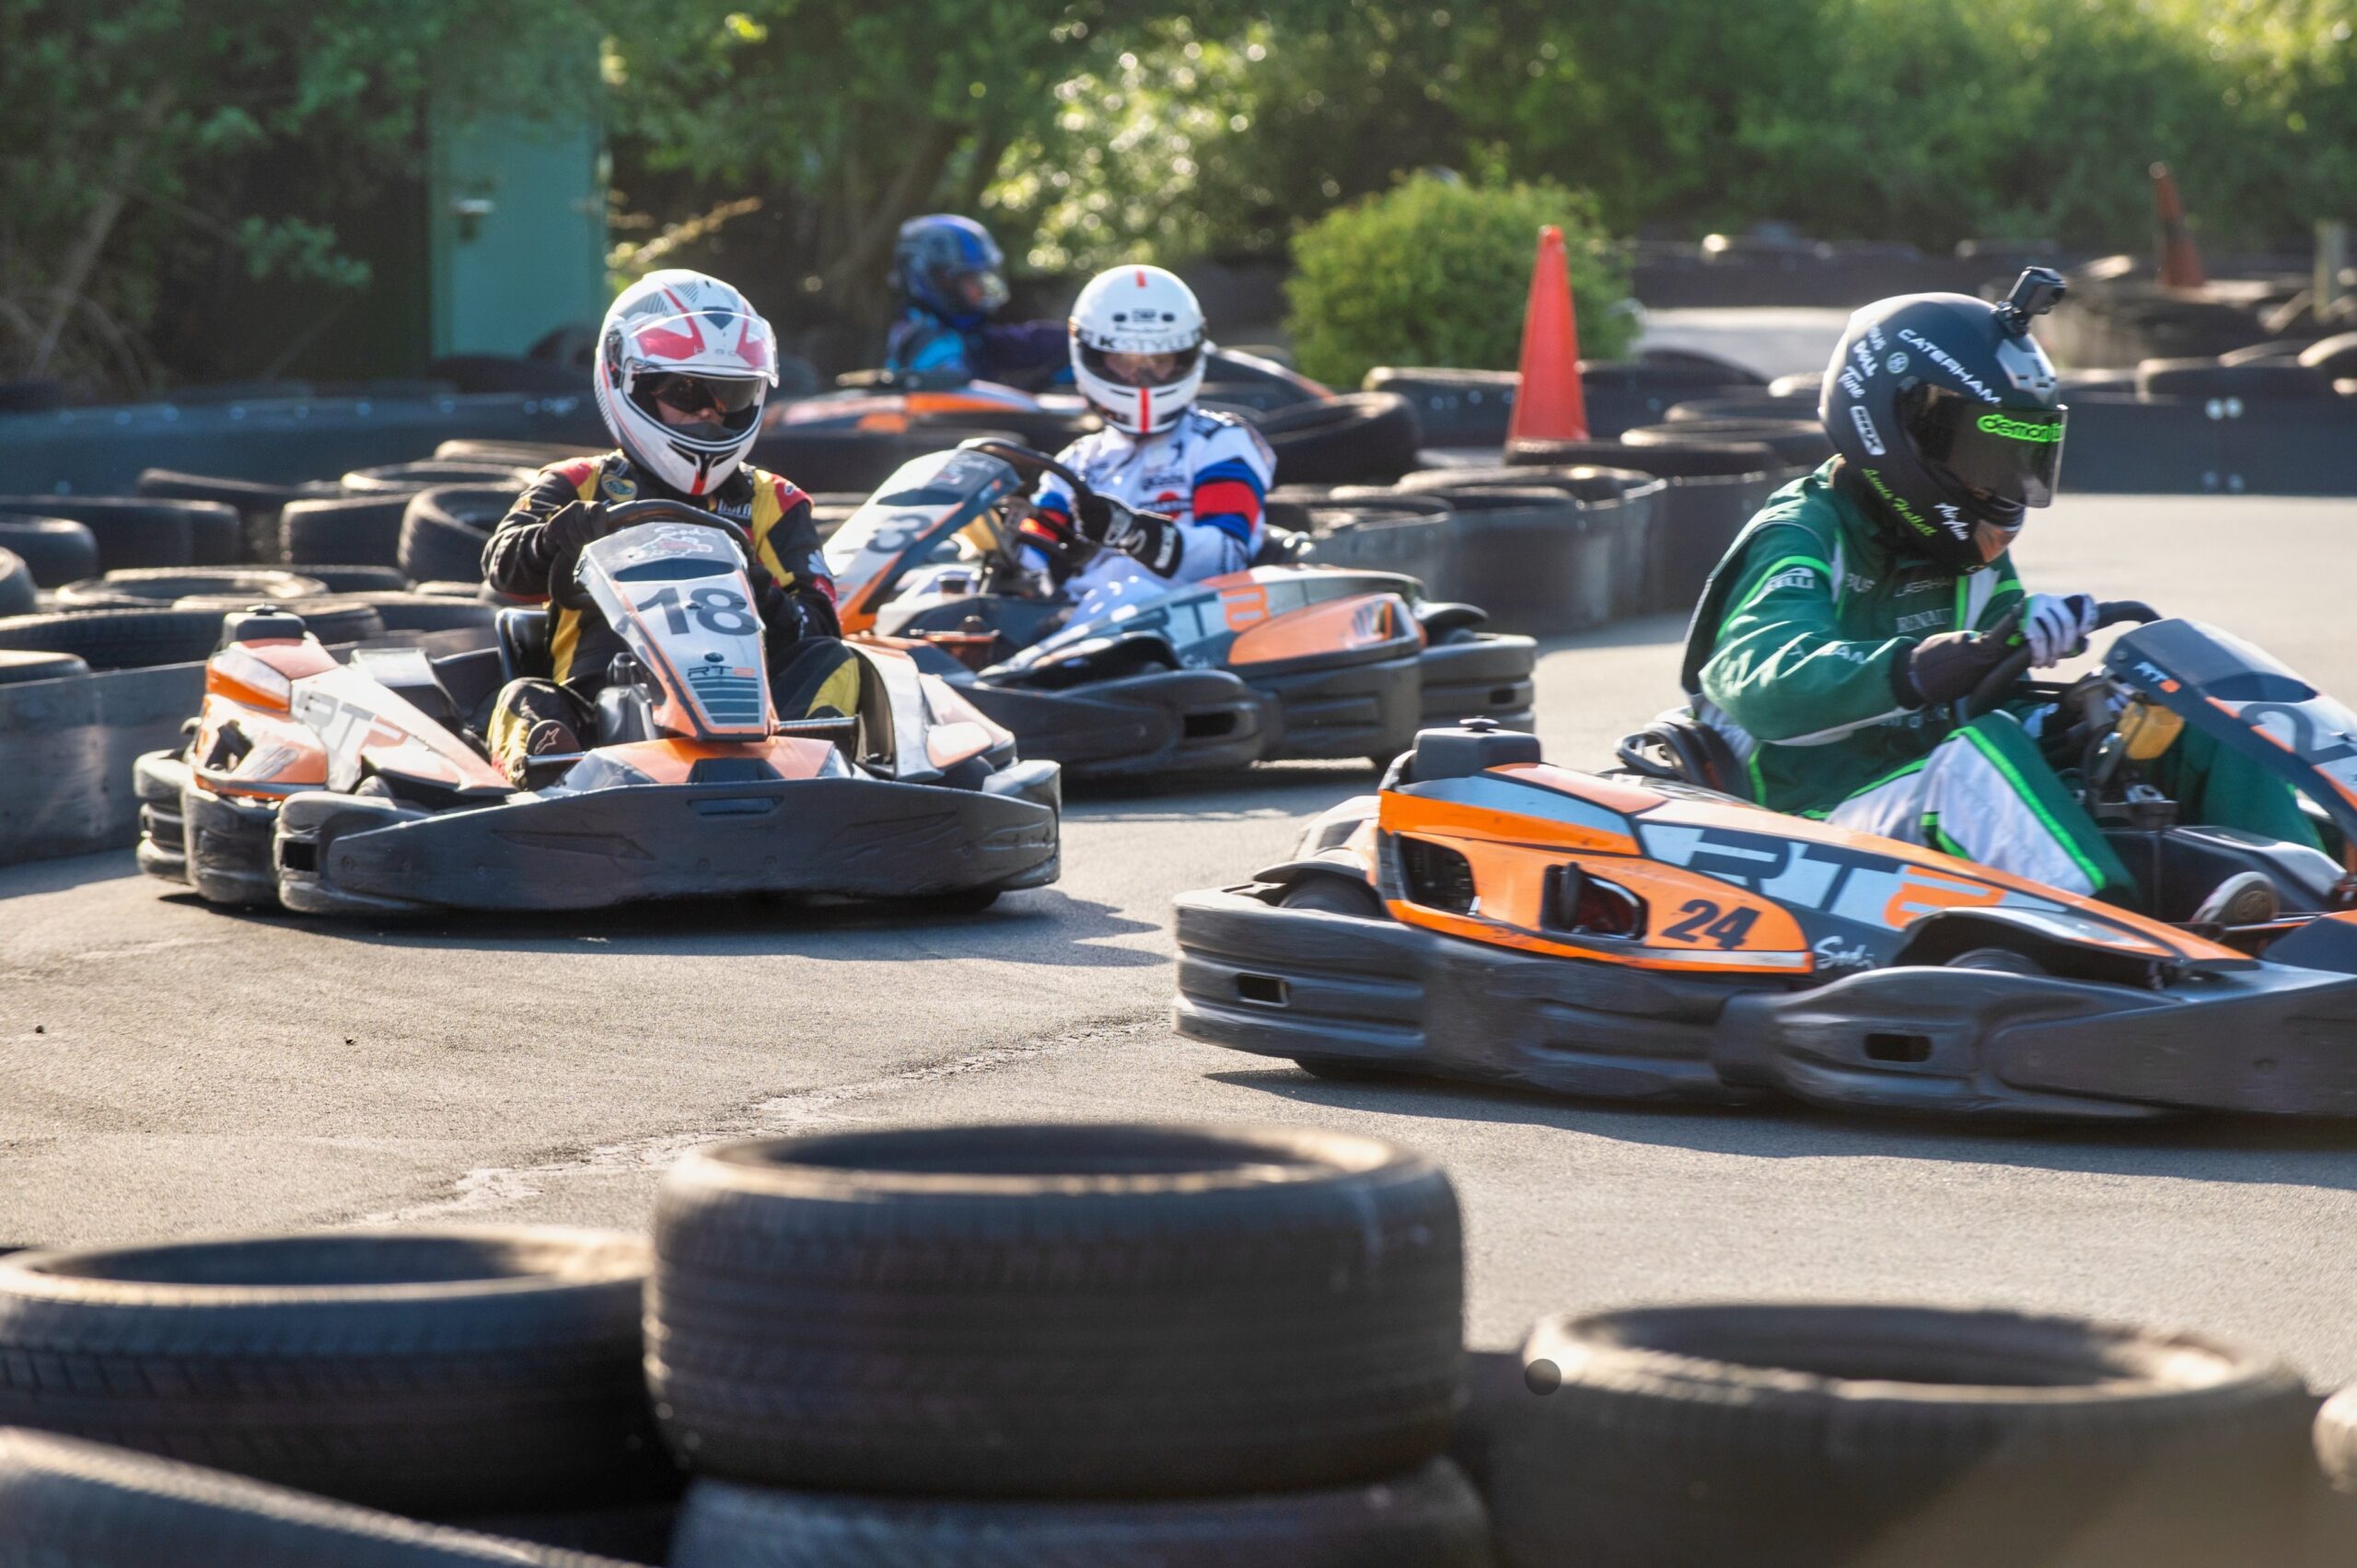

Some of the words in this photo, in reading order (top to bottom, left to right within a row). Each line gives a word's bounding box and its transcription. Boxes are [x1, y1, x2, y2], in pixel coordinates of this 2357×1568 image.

[1897, 329, 2003, 405] CATERHAM
[636, 587, 761, 637] 18
[1660, 899, 1761, 951] 24
